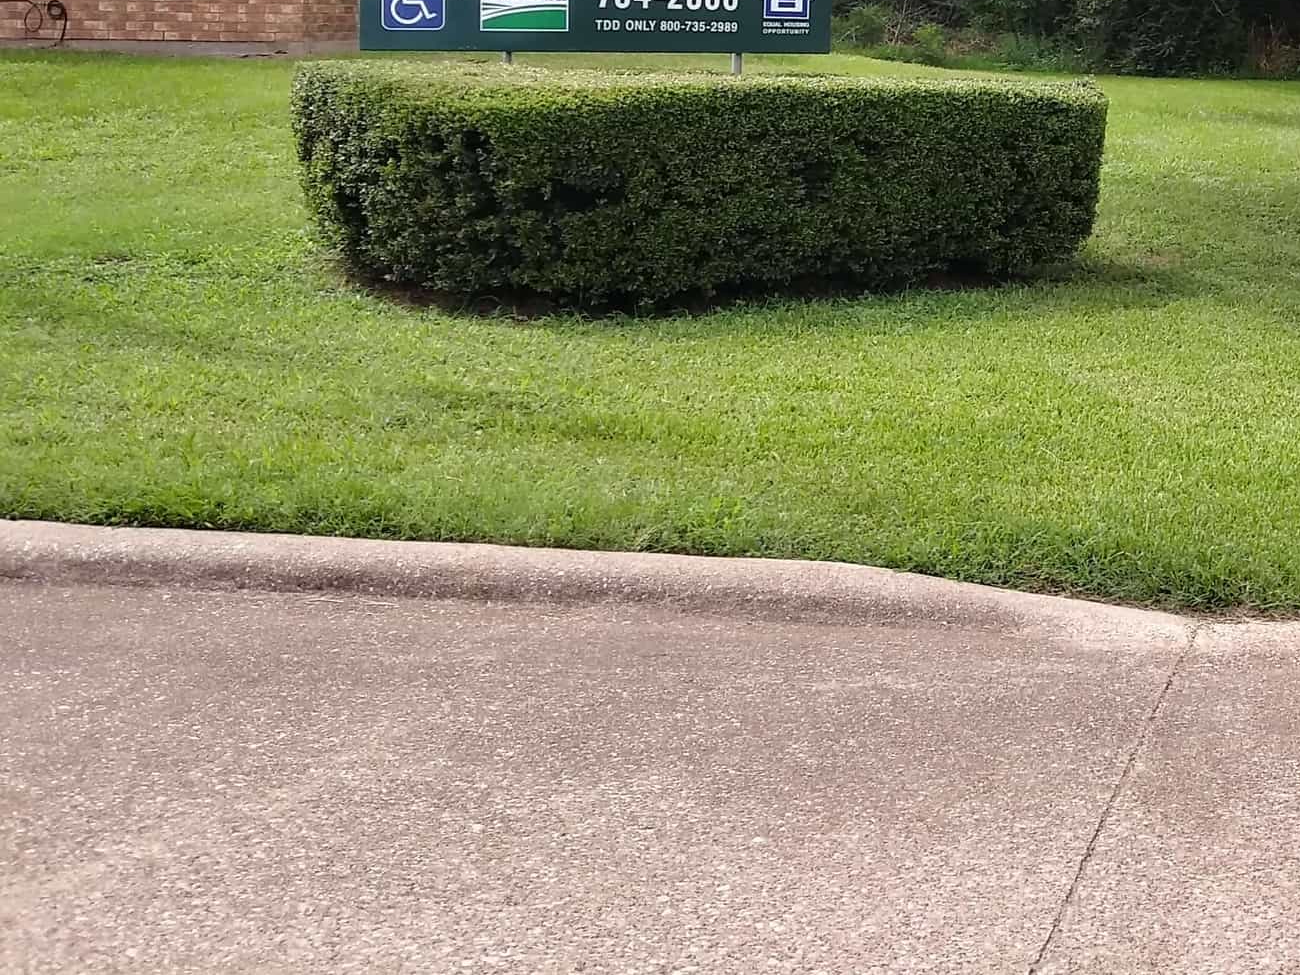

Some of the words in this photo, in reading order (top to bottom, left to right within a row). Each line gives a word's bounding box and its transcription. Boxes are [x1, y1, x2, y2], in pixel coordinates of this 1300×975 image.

[595, 19, 620, 31] TDD
[625, 20, 656, 31] ONLY
[660, 21, 738, 33] 800-735-2989
